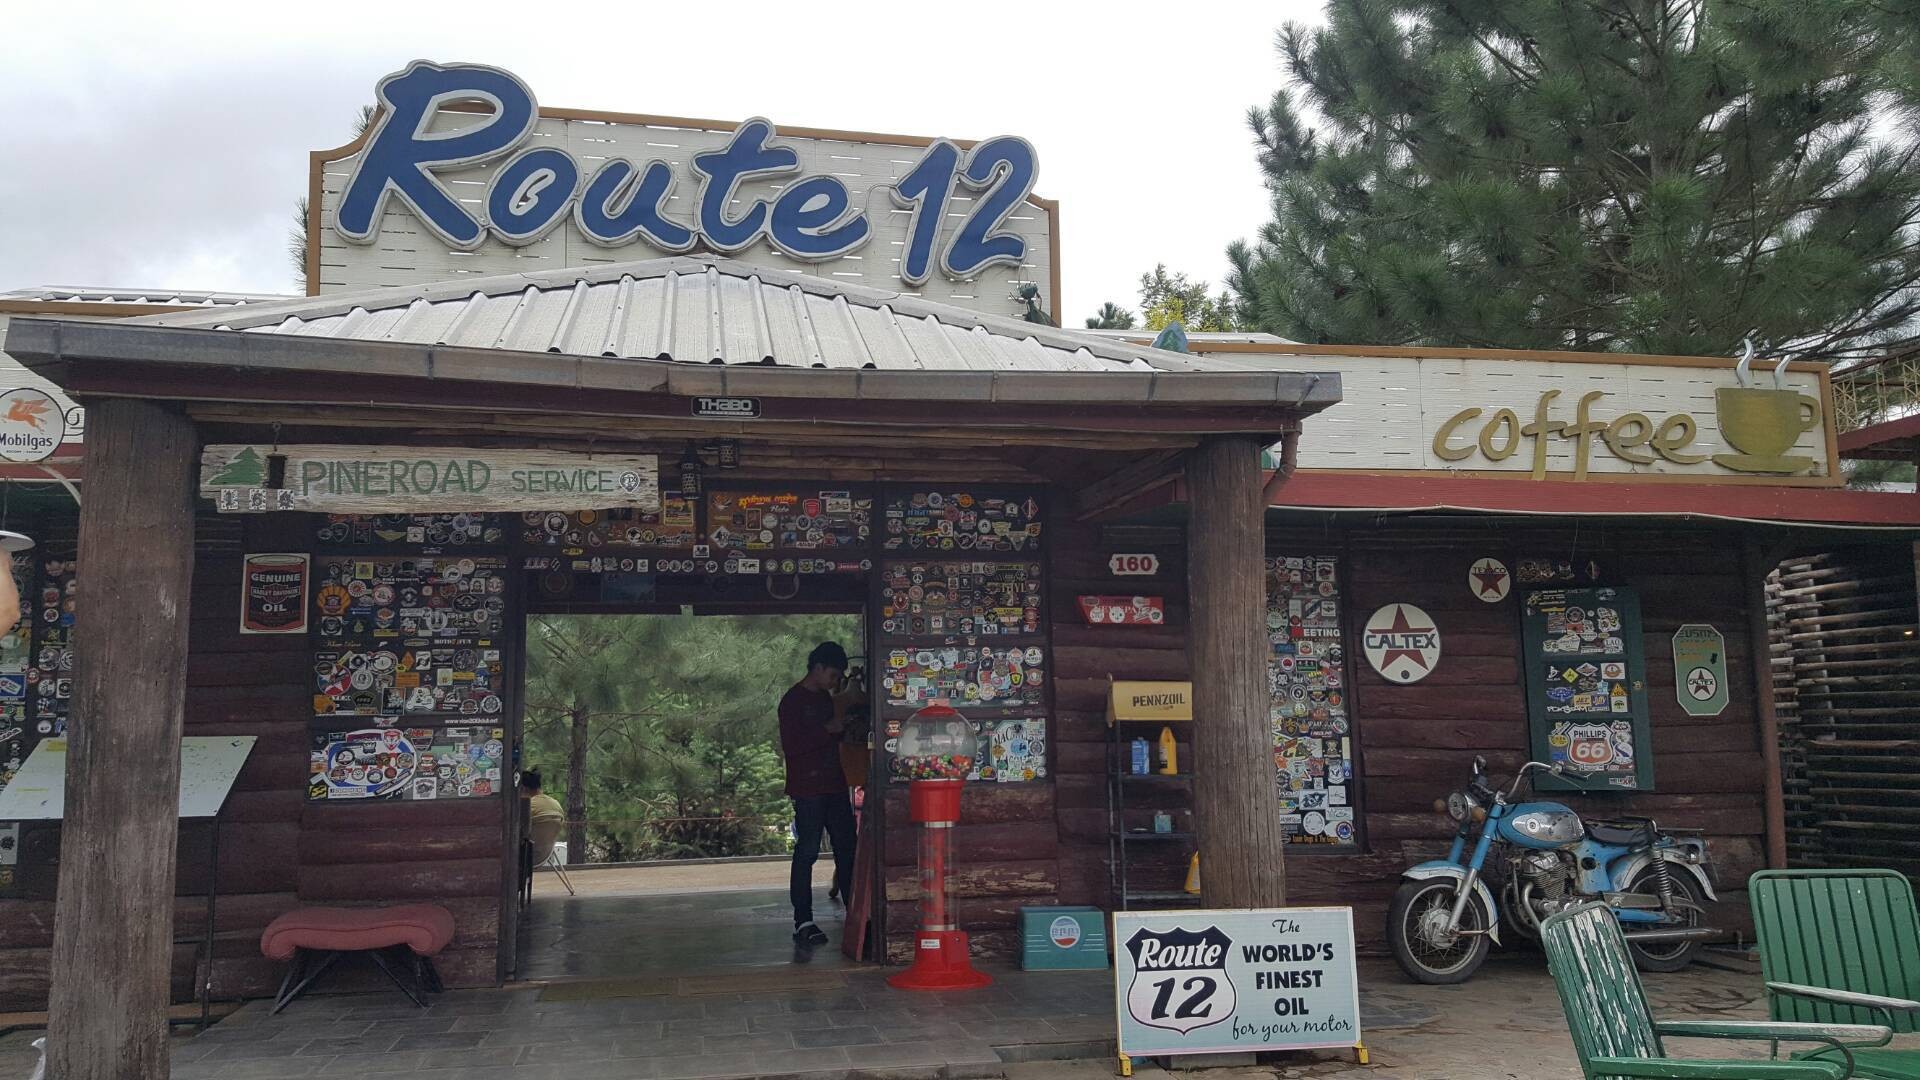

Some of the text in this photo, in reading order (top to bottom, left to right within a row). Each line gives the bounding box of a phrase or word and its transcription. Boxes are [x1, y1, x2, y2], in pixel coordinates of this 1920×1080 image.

[334, 59, 1039, 286] Route 12
[0, 432, 53, 450] Mobilgas
[302, 460, 491, 496] PINEROAD
[511, 470, 614, 494] SERVICE
[1115, 556, 1153, 572] 160
[251, 573, 301, 583] GENUINE
[262, 603, 287, 612] OIL
[1365, 633, 1437, 650] CALTEX
[1132, 693, 1186, 708] PENNZOIL
[1573, 729, 1607, 738] PHILLIPS
[1576, 741, 1606, 759] 66
[1272, 919, 1300, 934] The
[1137, 937, 1222, 969] Route
[1242, 943, 1334, 963] WORLD'S
[1256, 970, 1324, 990] FINEST
[1150, 976, 1218, 1020] 12
[1274, 997, 1310, 1017] OIL
[1232, 1014, 1353, 1042] for your motor
